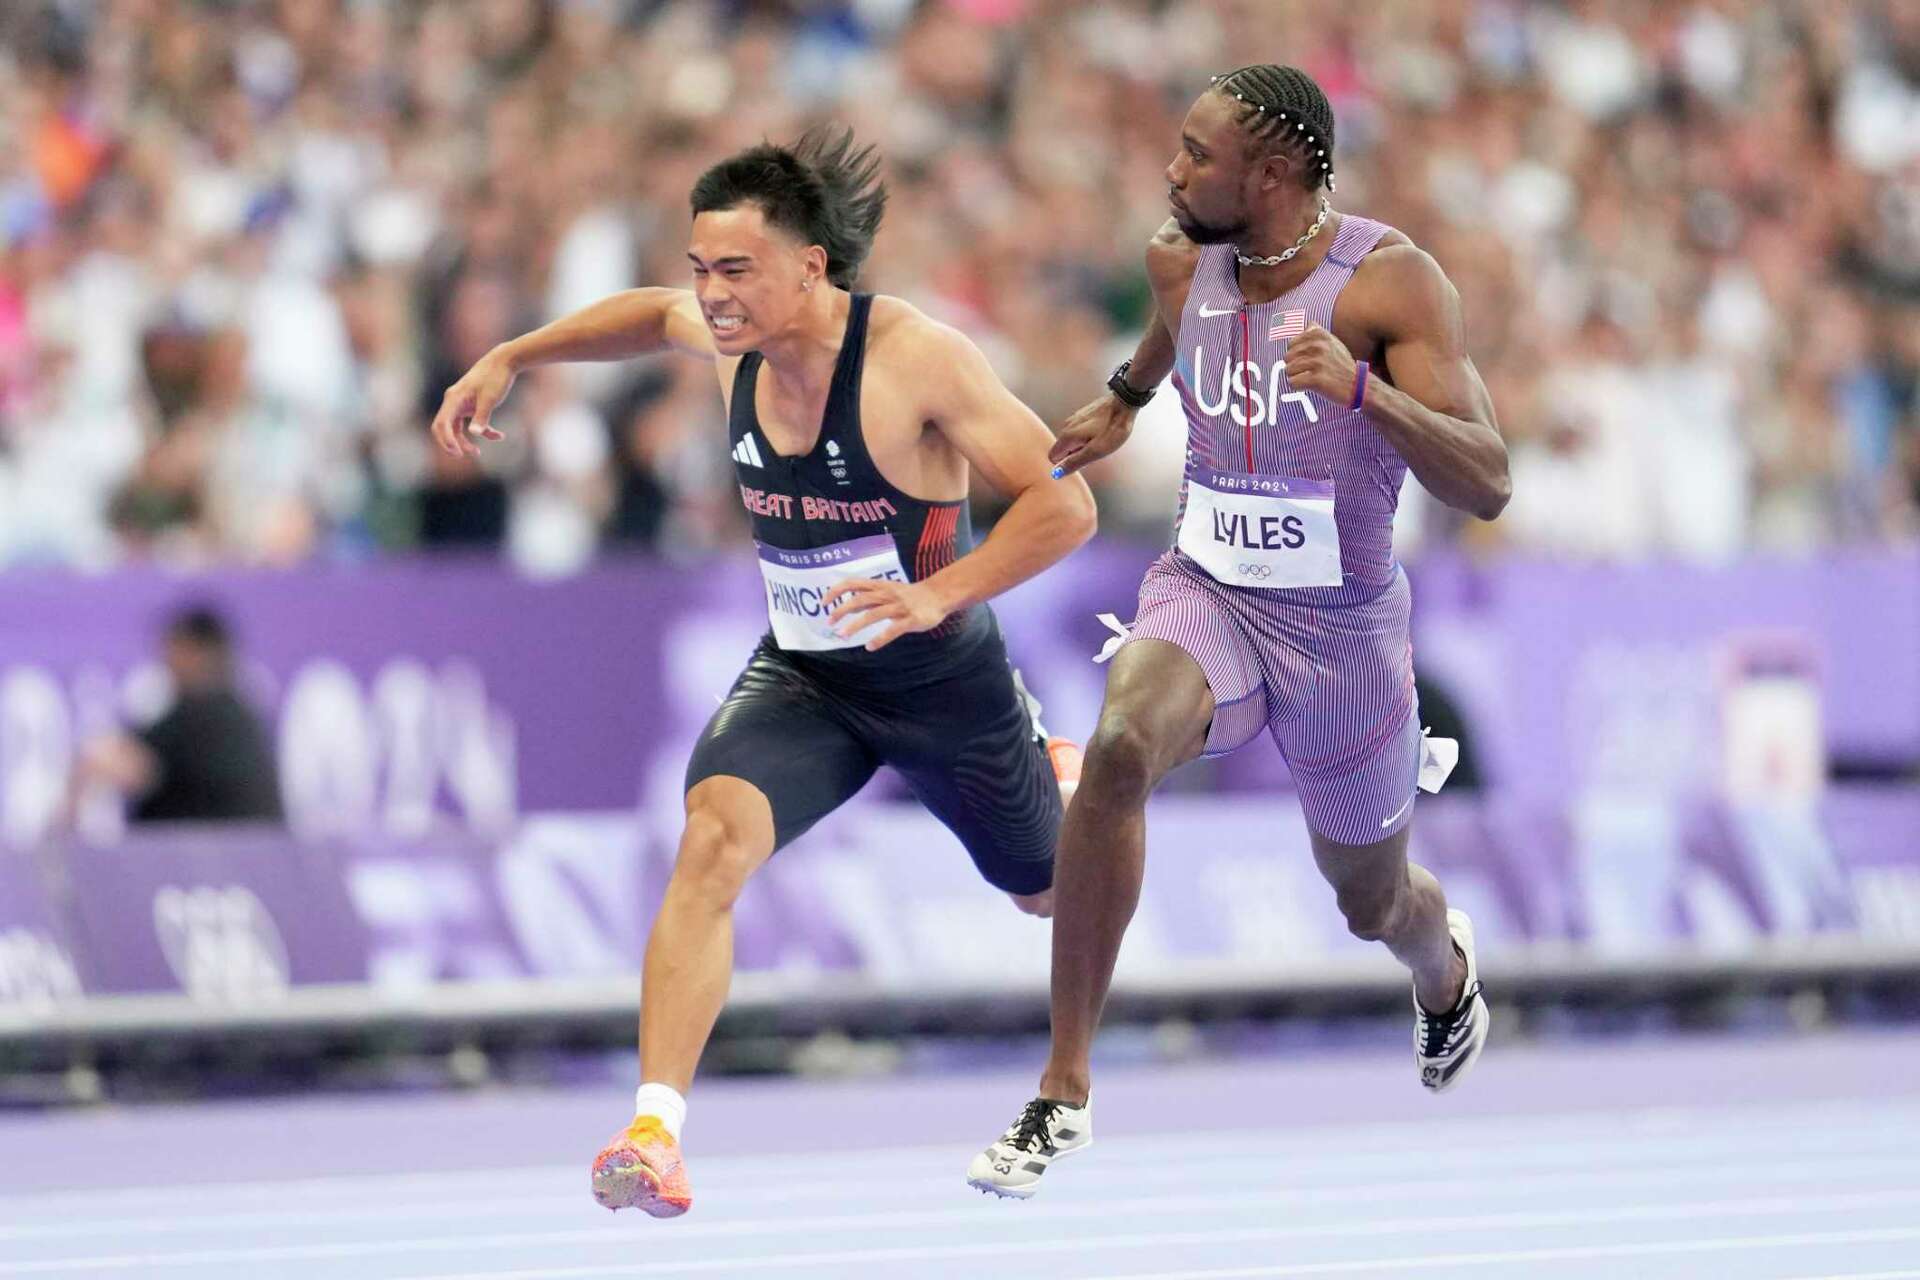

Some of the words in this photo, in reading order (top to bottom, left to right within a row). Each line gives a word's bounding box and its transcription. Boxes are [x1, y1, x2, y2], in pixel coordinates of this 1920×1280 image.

[1194, 345, 1319, 426] USA
[1212, 475, 1247, 490] PARIS
[1252, 480, 1289, 492] 2024
[801, 496, 898, 524] BRITAIN
[1213, 507, 1306, 550] LYLES
[778, 552, 811, 565] PARIS
[813, 547, 851, 564] 2024
